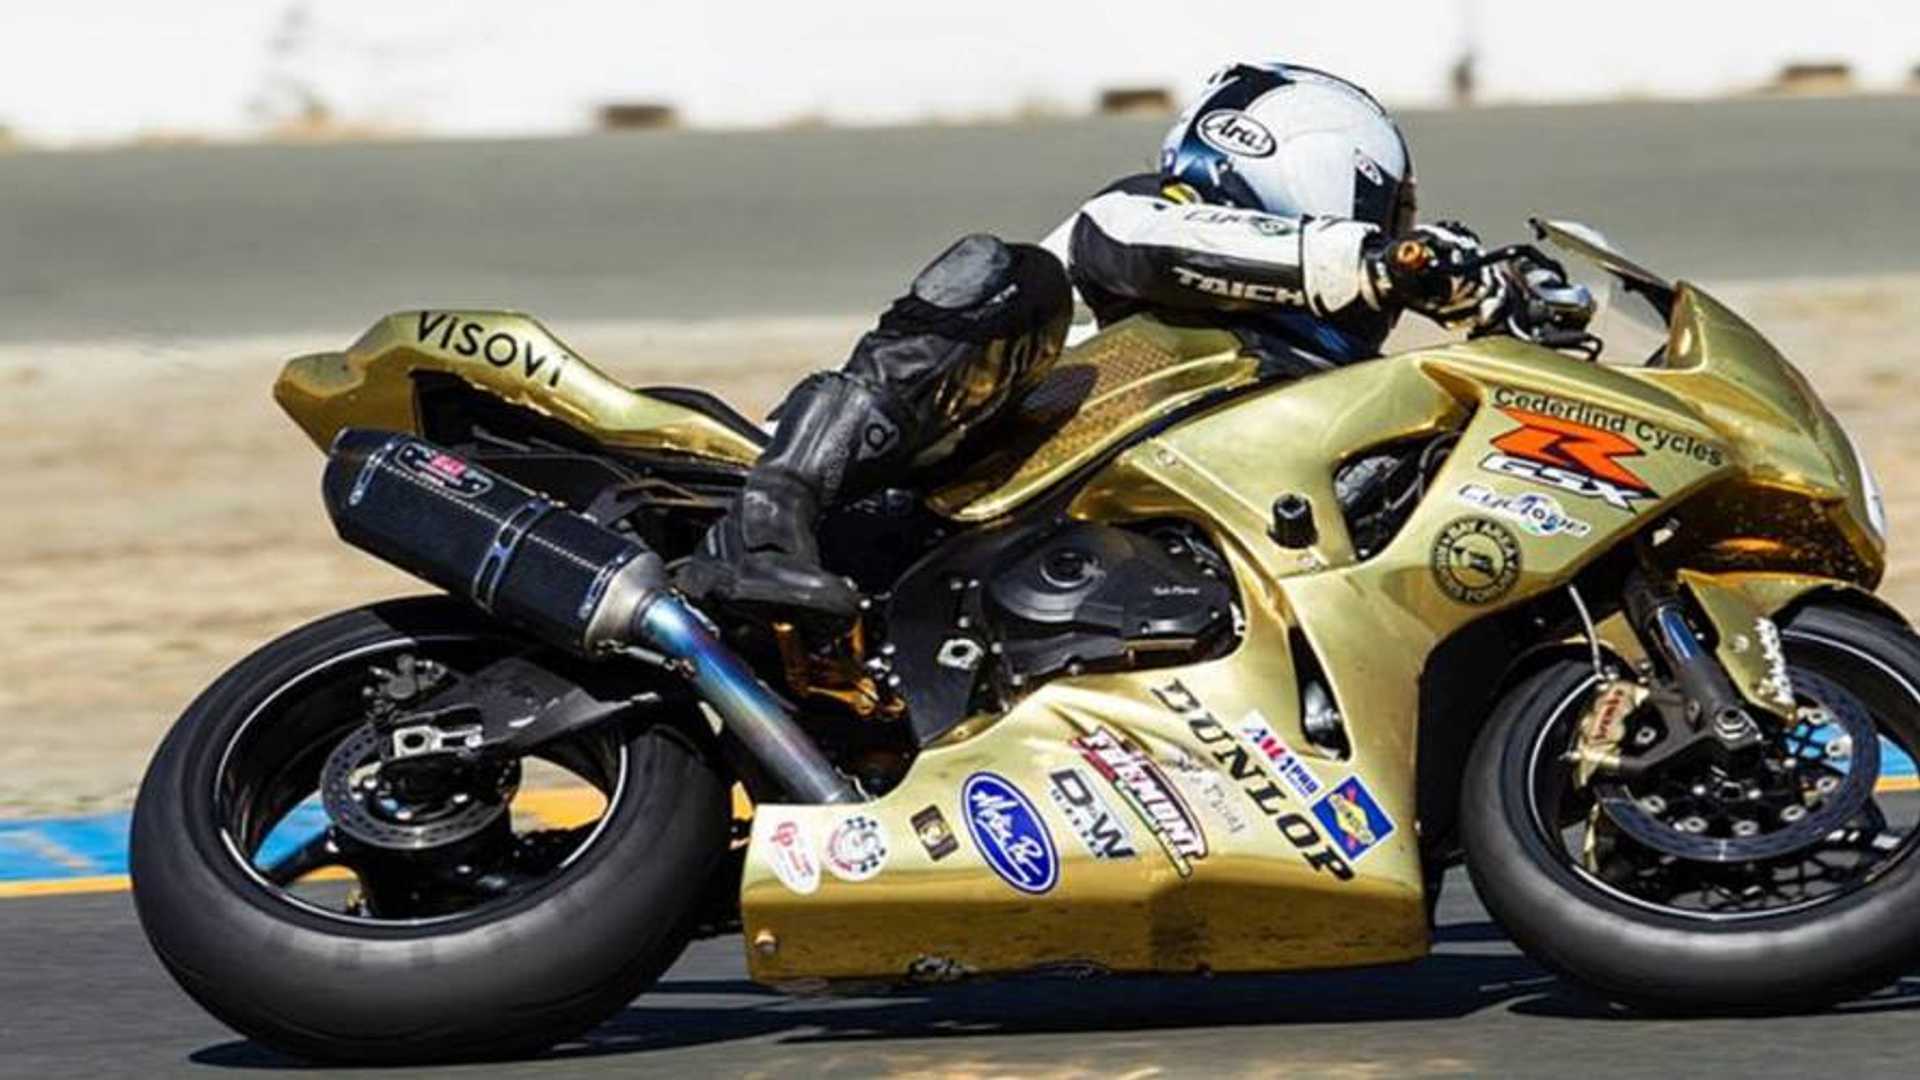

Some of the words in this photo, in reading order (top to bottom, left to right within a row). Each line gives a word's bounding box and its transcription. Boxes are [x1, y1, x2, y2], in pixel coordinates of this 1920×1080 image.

[1494, 386, 1626, 433] Cederlind
[1635, 421, 1723, 467] Cycles
[1150, 679, 1355, 881] DUNLOP
